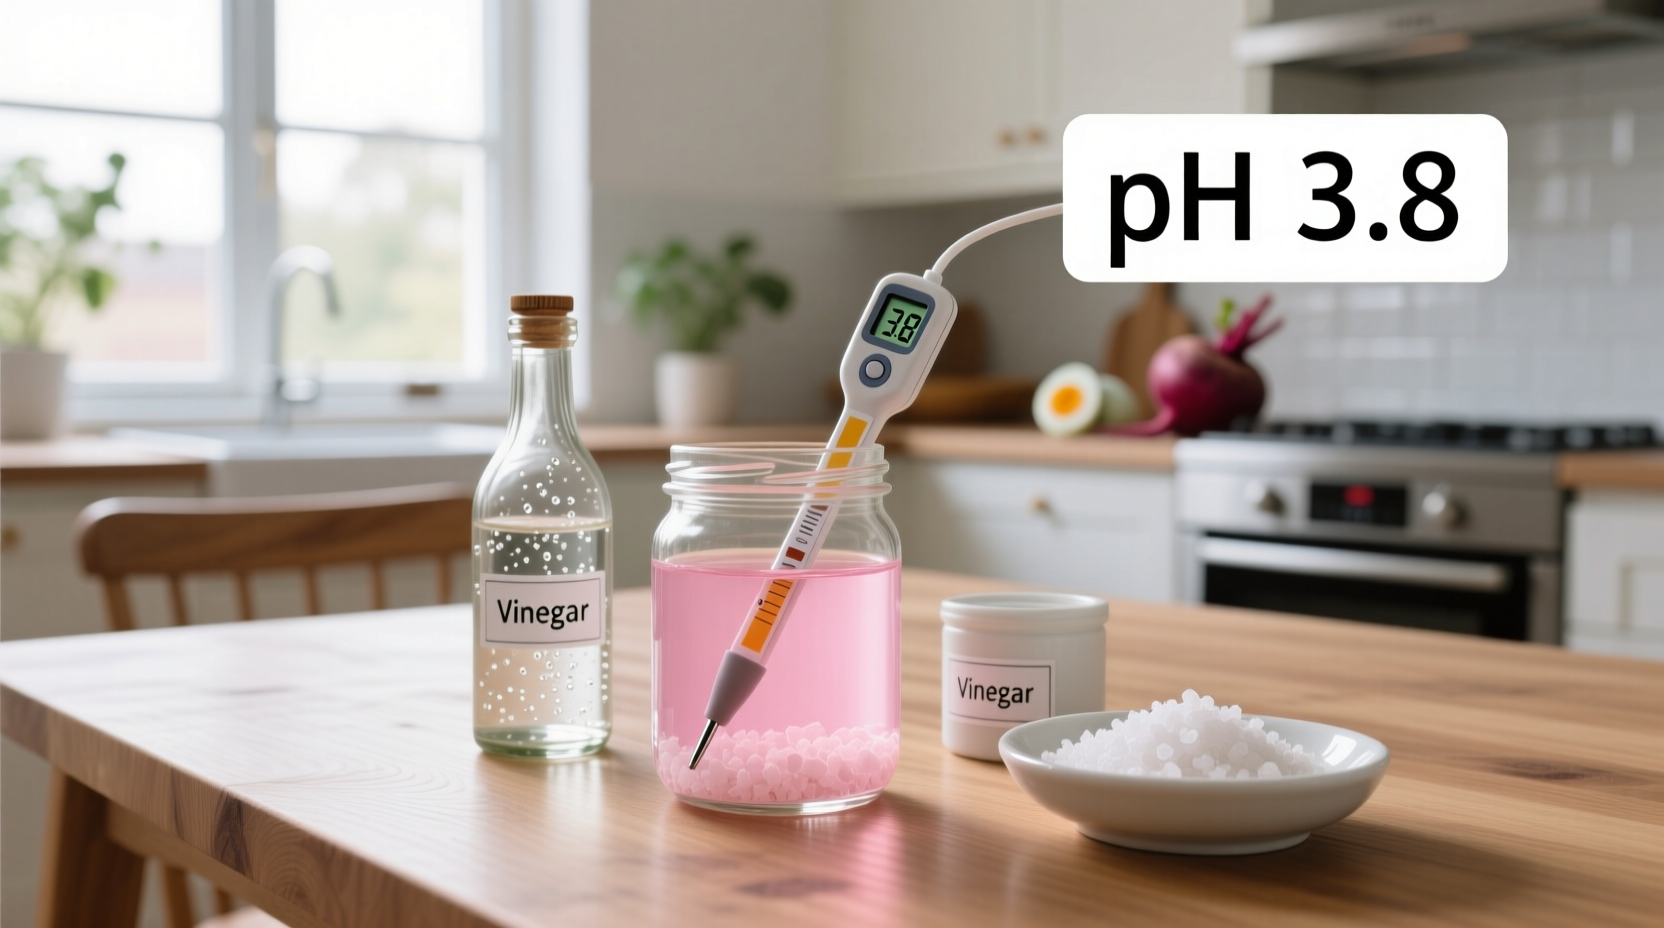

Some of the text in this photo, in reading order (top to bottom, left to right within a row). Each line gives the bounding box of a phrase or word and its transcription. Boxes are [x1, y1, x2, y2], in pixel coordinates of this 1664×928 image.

[882, 307, 922, 344] 3.8
[497, 599, 589, 630] Vinegar
[957, 676, 1035, 709] Vinegar
